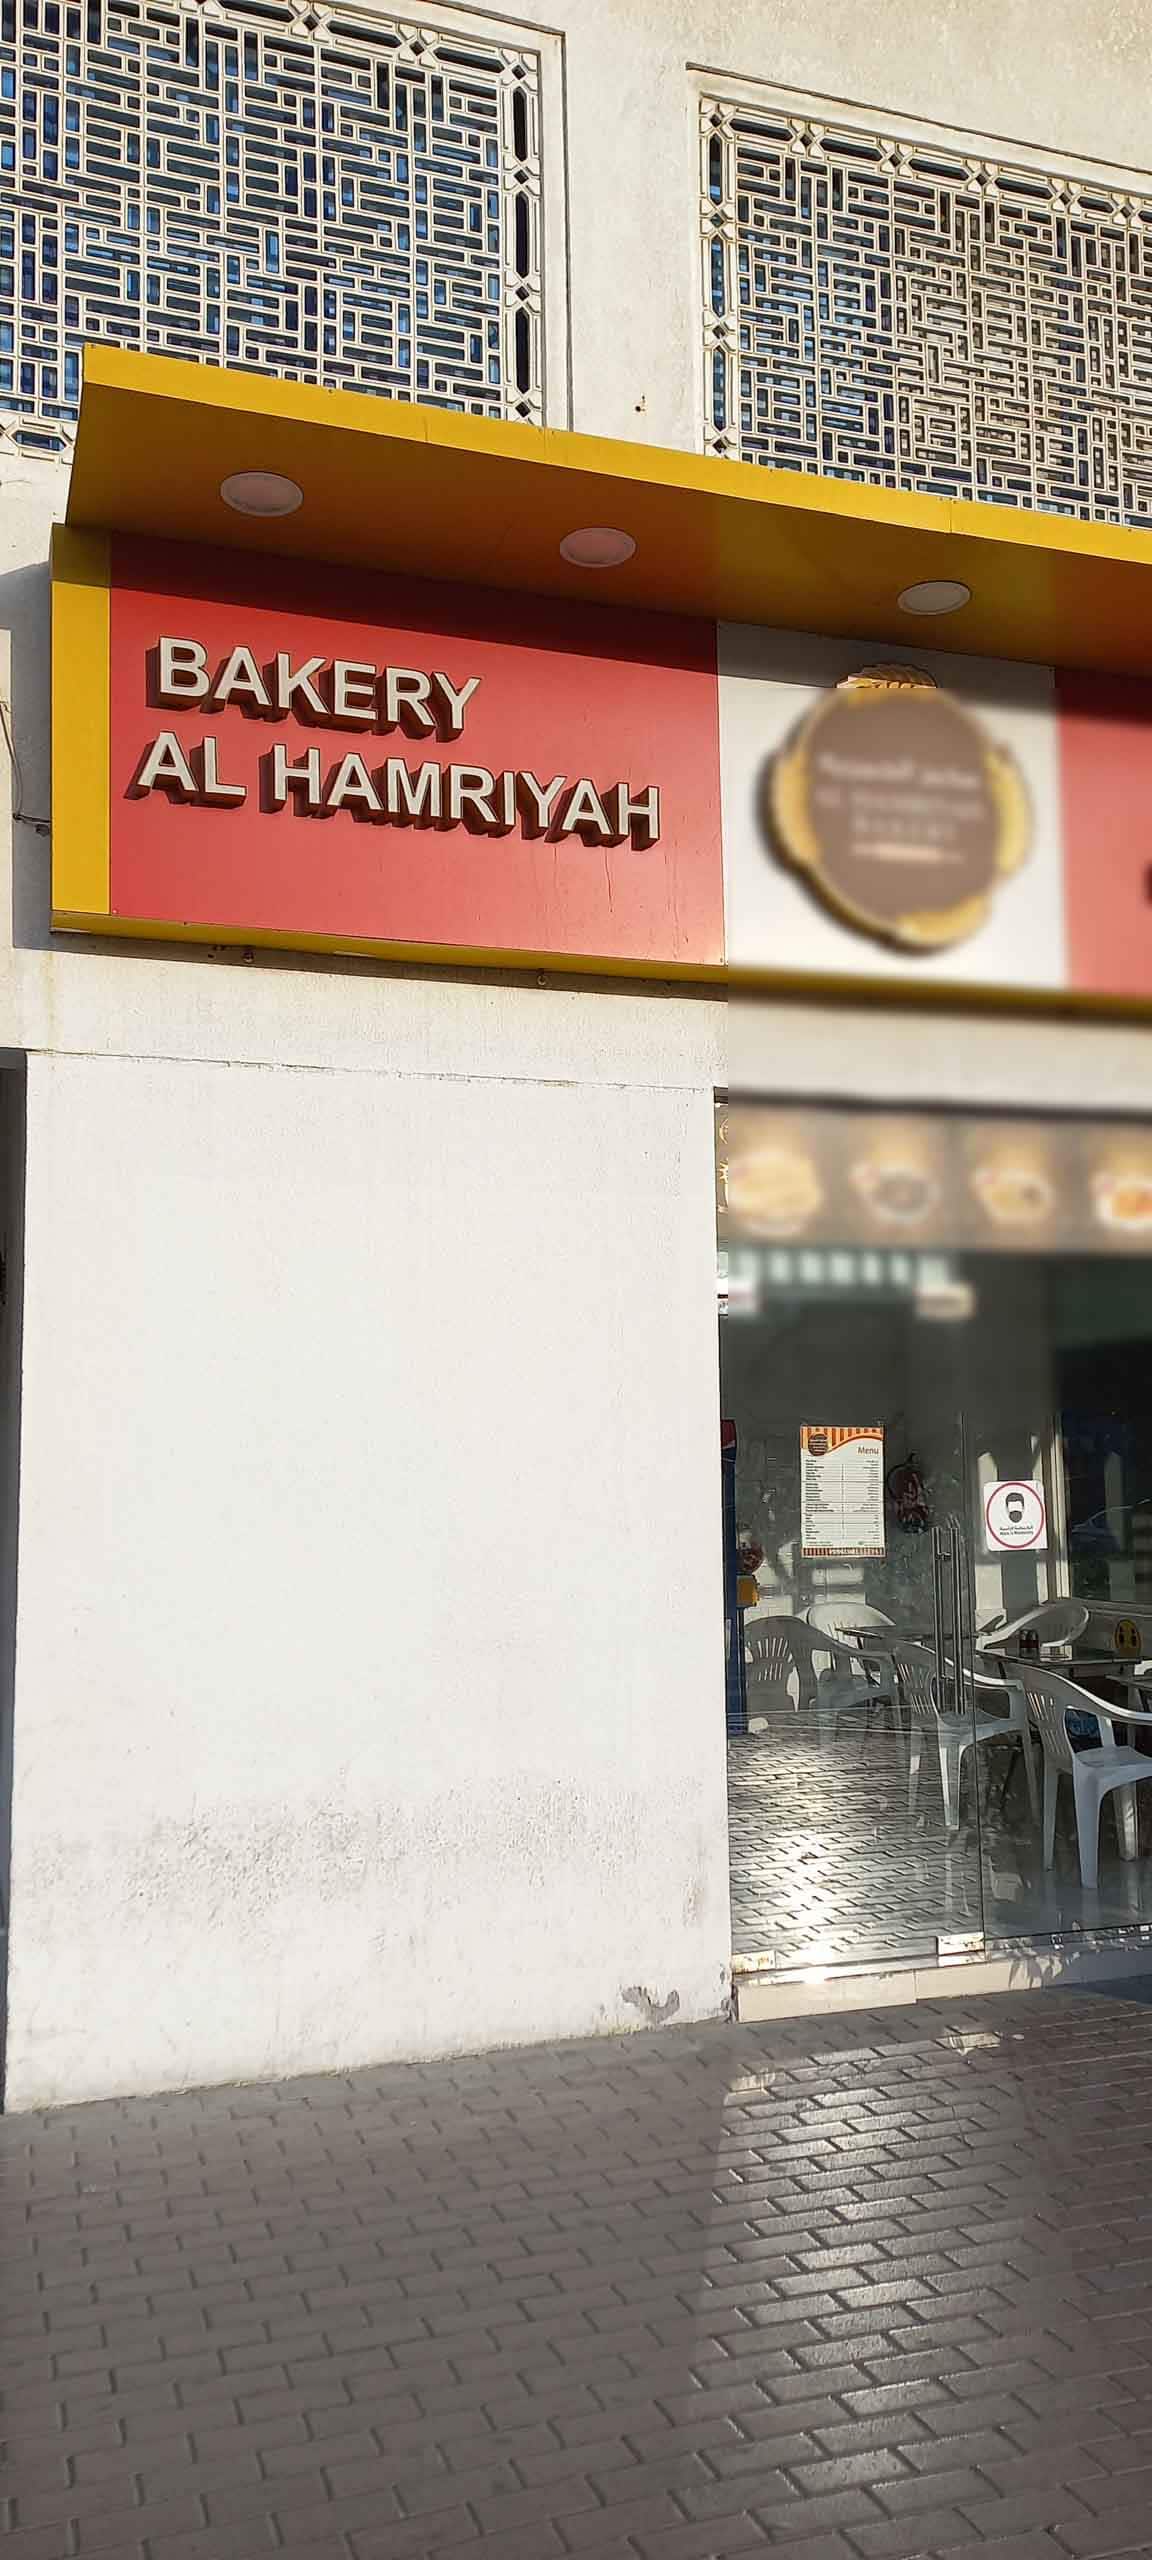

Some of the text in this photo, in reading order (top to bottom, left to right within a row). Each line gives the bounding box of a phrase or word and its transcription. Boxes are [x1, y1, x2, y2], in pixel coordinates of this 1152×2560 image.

[152, 635, 482, 735] BAKERY
[131, 730, 661, 845] AL HAMRIYAH
[857, 1445, 880, 1455] Menu
